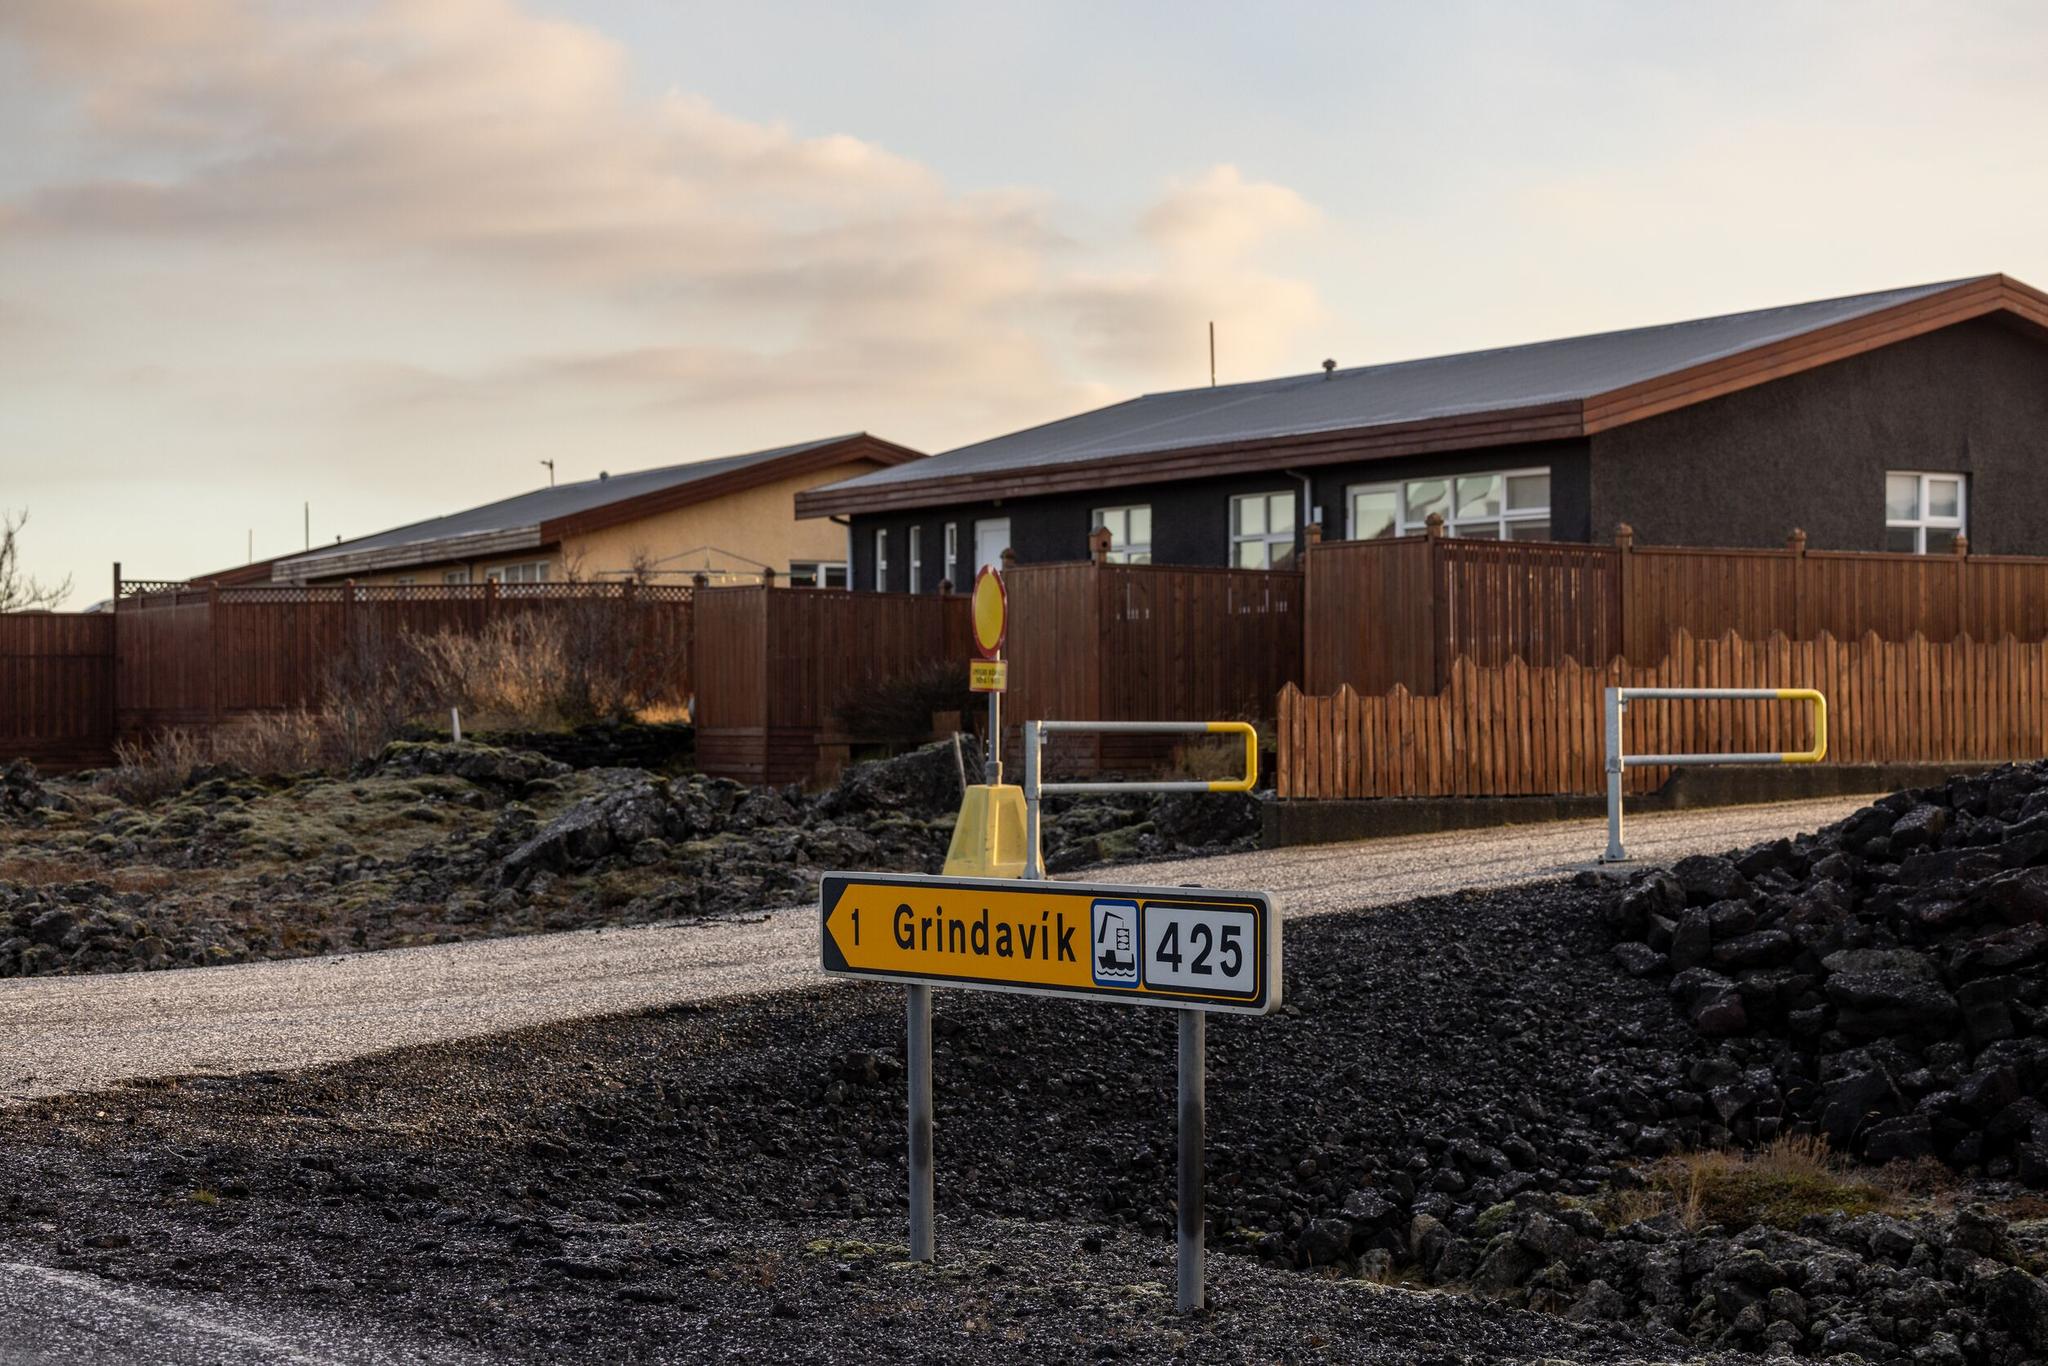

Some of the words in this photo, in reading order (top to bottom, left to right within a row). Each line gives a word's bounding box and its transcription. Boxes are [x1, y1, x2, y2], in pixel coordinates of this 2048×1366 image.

[850, 908, 860, 946] 1
[893, 903, 1077, 962] Grindavík
[1155, 921, 1243, 978] 425
